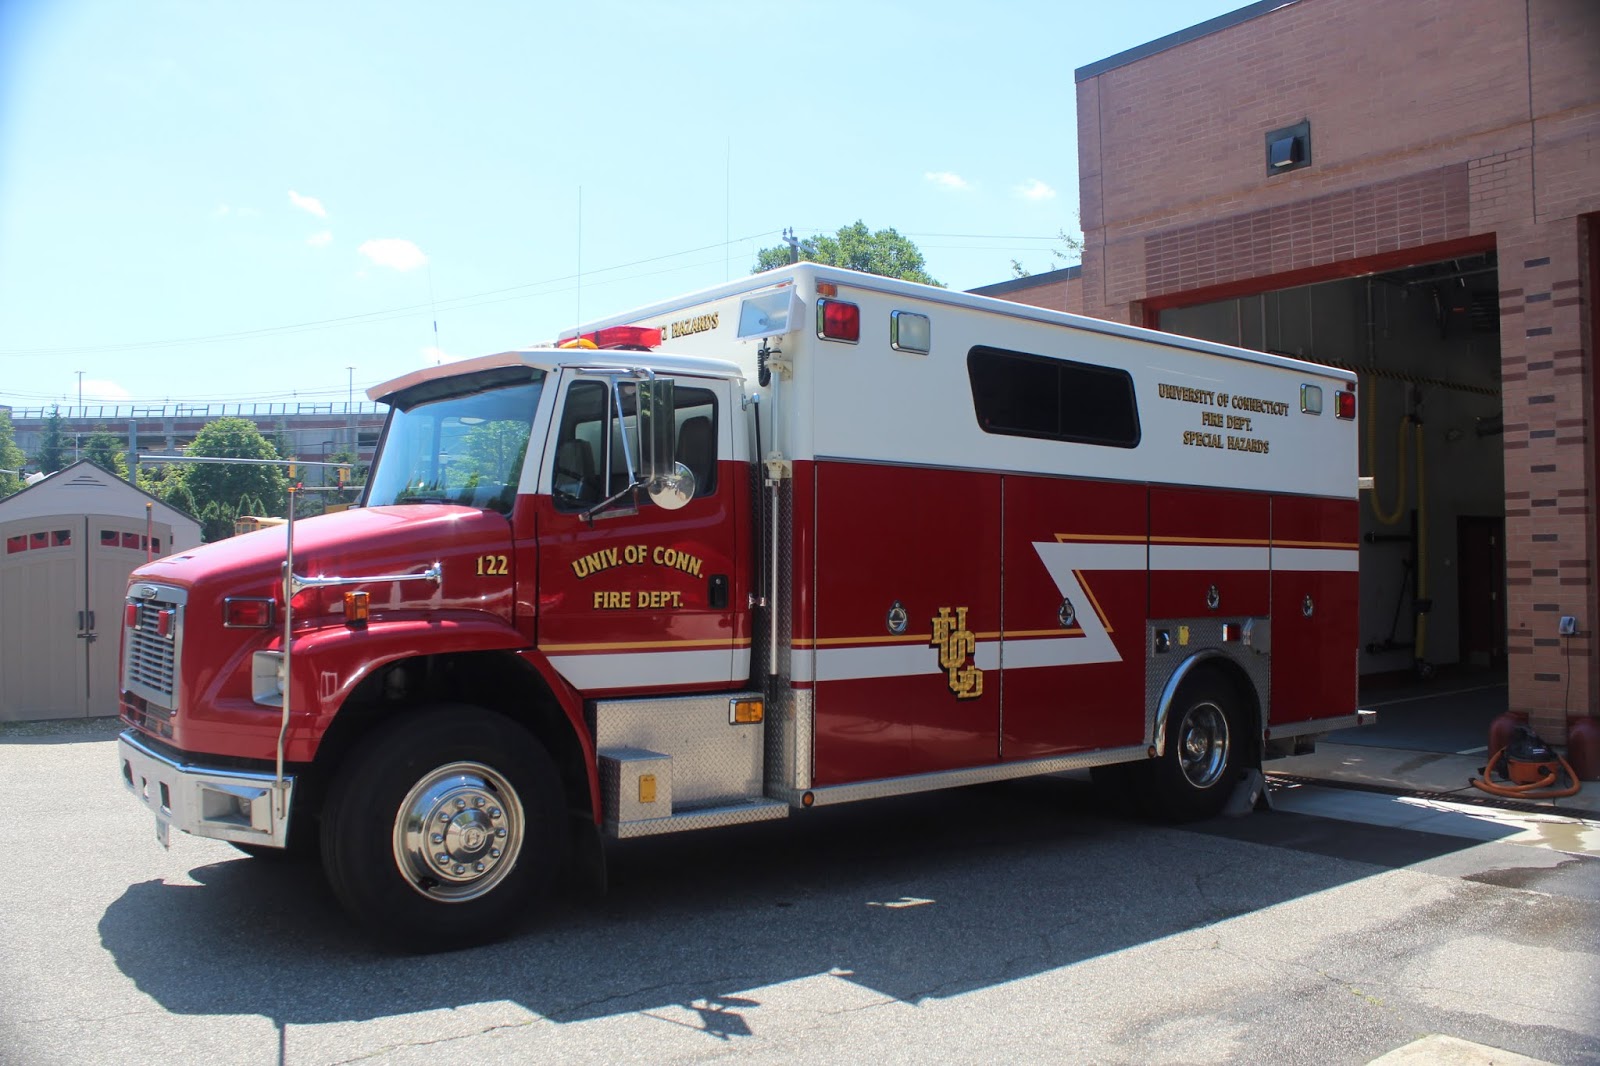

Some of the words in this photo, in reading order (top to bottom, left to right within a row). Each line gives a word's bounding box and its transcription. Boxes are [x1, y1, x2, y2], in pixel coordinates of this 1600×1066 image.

[671, 312, 719, 339] HAZARDS
[1158, 383, 1215, 406] UNIVERSITY
[1217, 392, 1229, 408] OF
[1231, 395, 1290, 417] CONNECTICUT
[1202, 411, 1224, 428] FIRE
[1226, 415, 1253, 432] DEPT.
[1183, 430, 1224, 449] SPECIAL
[1227, 436, 1270, 454] HAZARDS
[476, 555, 508, 576] 122
[571, 547, 623, 579] UNIV.
[624, 544, 648, 564] OF
[652, 546, 704, 579] CONN.
[593, 591, 631, 609] FIRE
[637, 591, 684, 609] DEPT.
